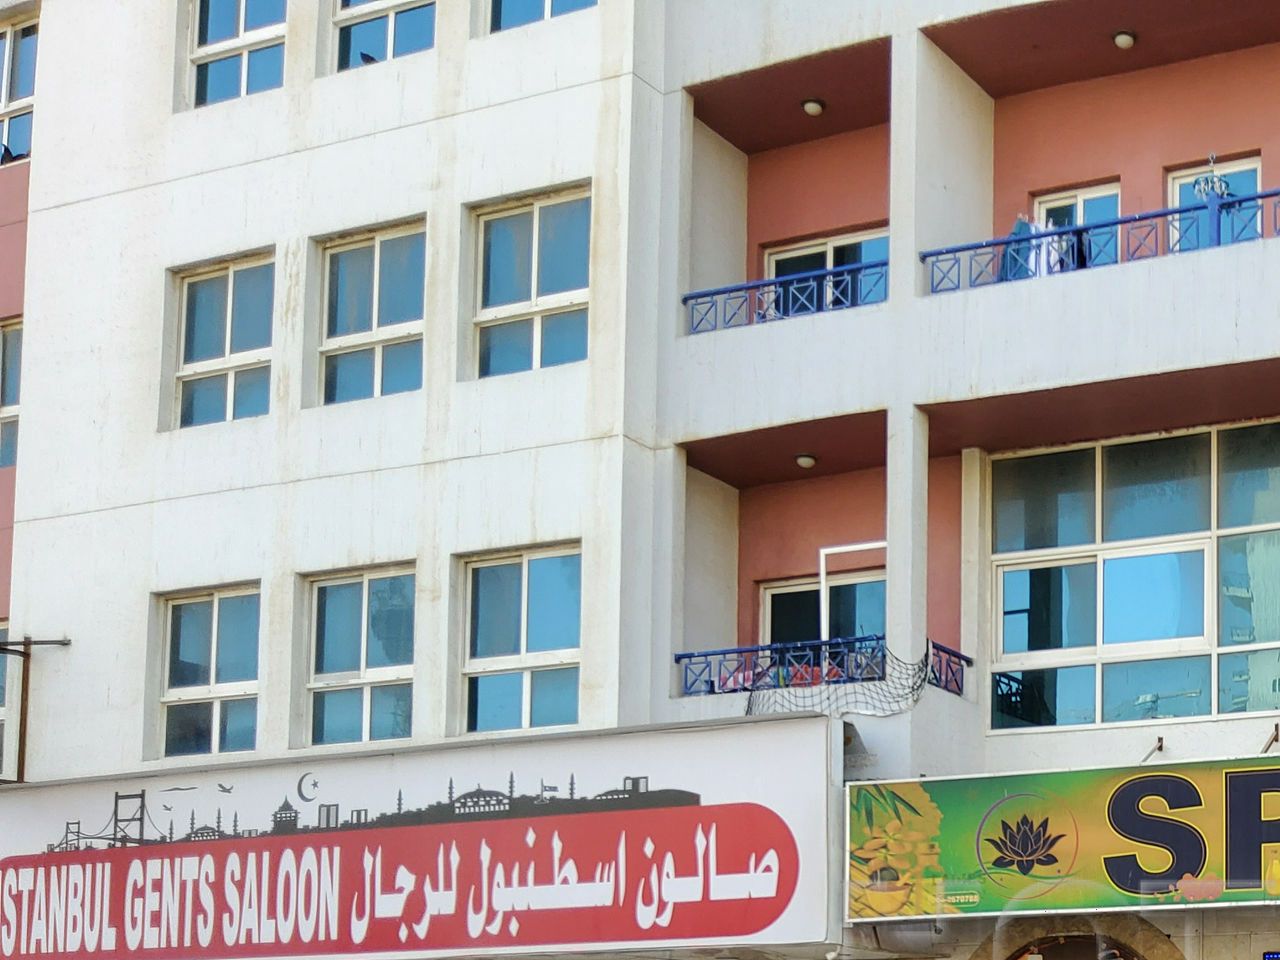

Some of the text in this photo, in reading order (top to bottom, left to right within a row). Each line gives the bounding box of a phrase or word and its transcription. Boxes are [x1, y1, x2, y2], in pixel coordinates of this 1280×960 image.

[0, 846, 341, 957] STANBUL GENTS SALOON
[350, 822, 780, 945] صالون اسطنبول للرجال
